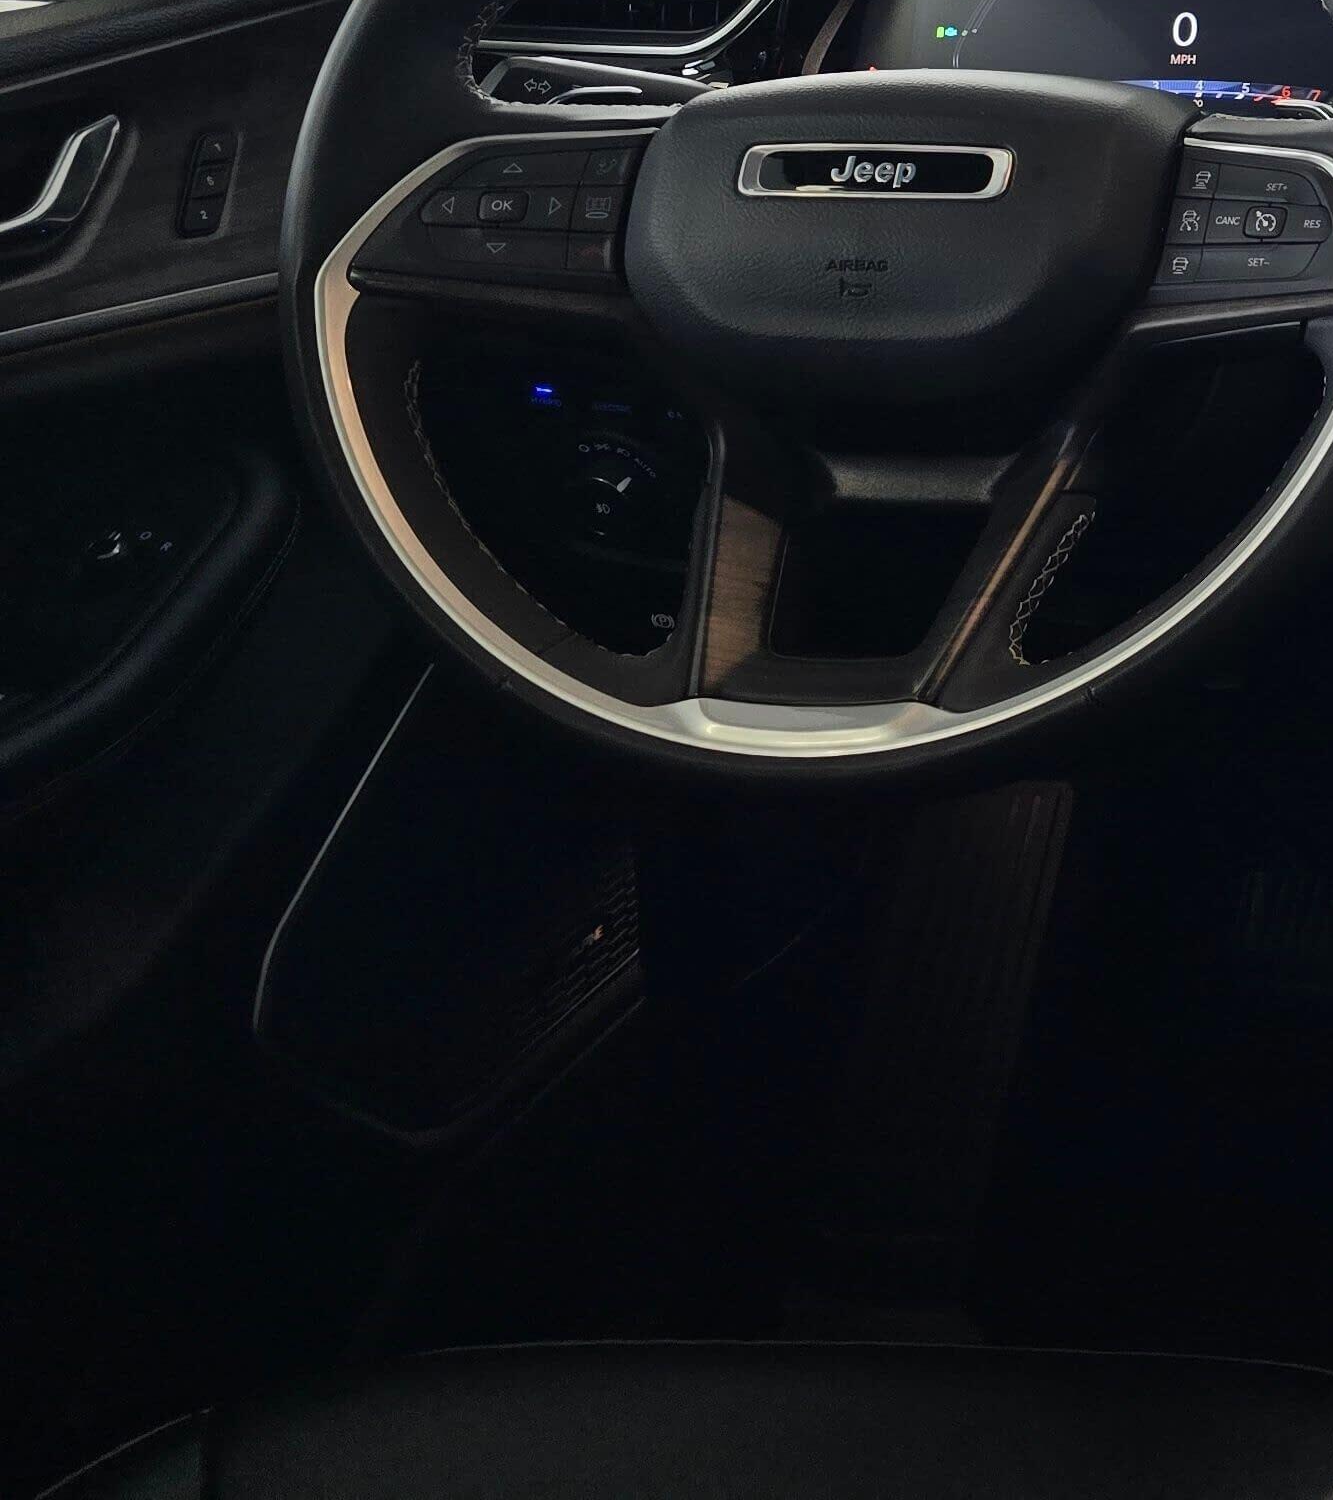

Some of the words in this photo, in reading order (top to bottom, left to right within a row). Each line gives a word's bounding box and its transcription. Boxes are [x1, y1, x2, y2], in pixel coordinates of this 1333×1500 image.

[1172, 12, 1198, 47] 0
[1170, 54, 1196, 65] MPH
[1195, 80, 1204, 90] 4
[1242, 83, 1250, 93] 5
[1282, 86, 1290, 98] 6
[1311, 90, 1322, 101] 7
[830, 155, 917, 188] Jeep
[1266, 182, 1288, 192] SET+
[491, 199, 513, 213] OK
[200, 210, 208, 220] 2
[1215, 216, 1241, 226] CANC
[1303, 220, 1322, 229] RES
[825, 258, 889, 272] AIRBAG
